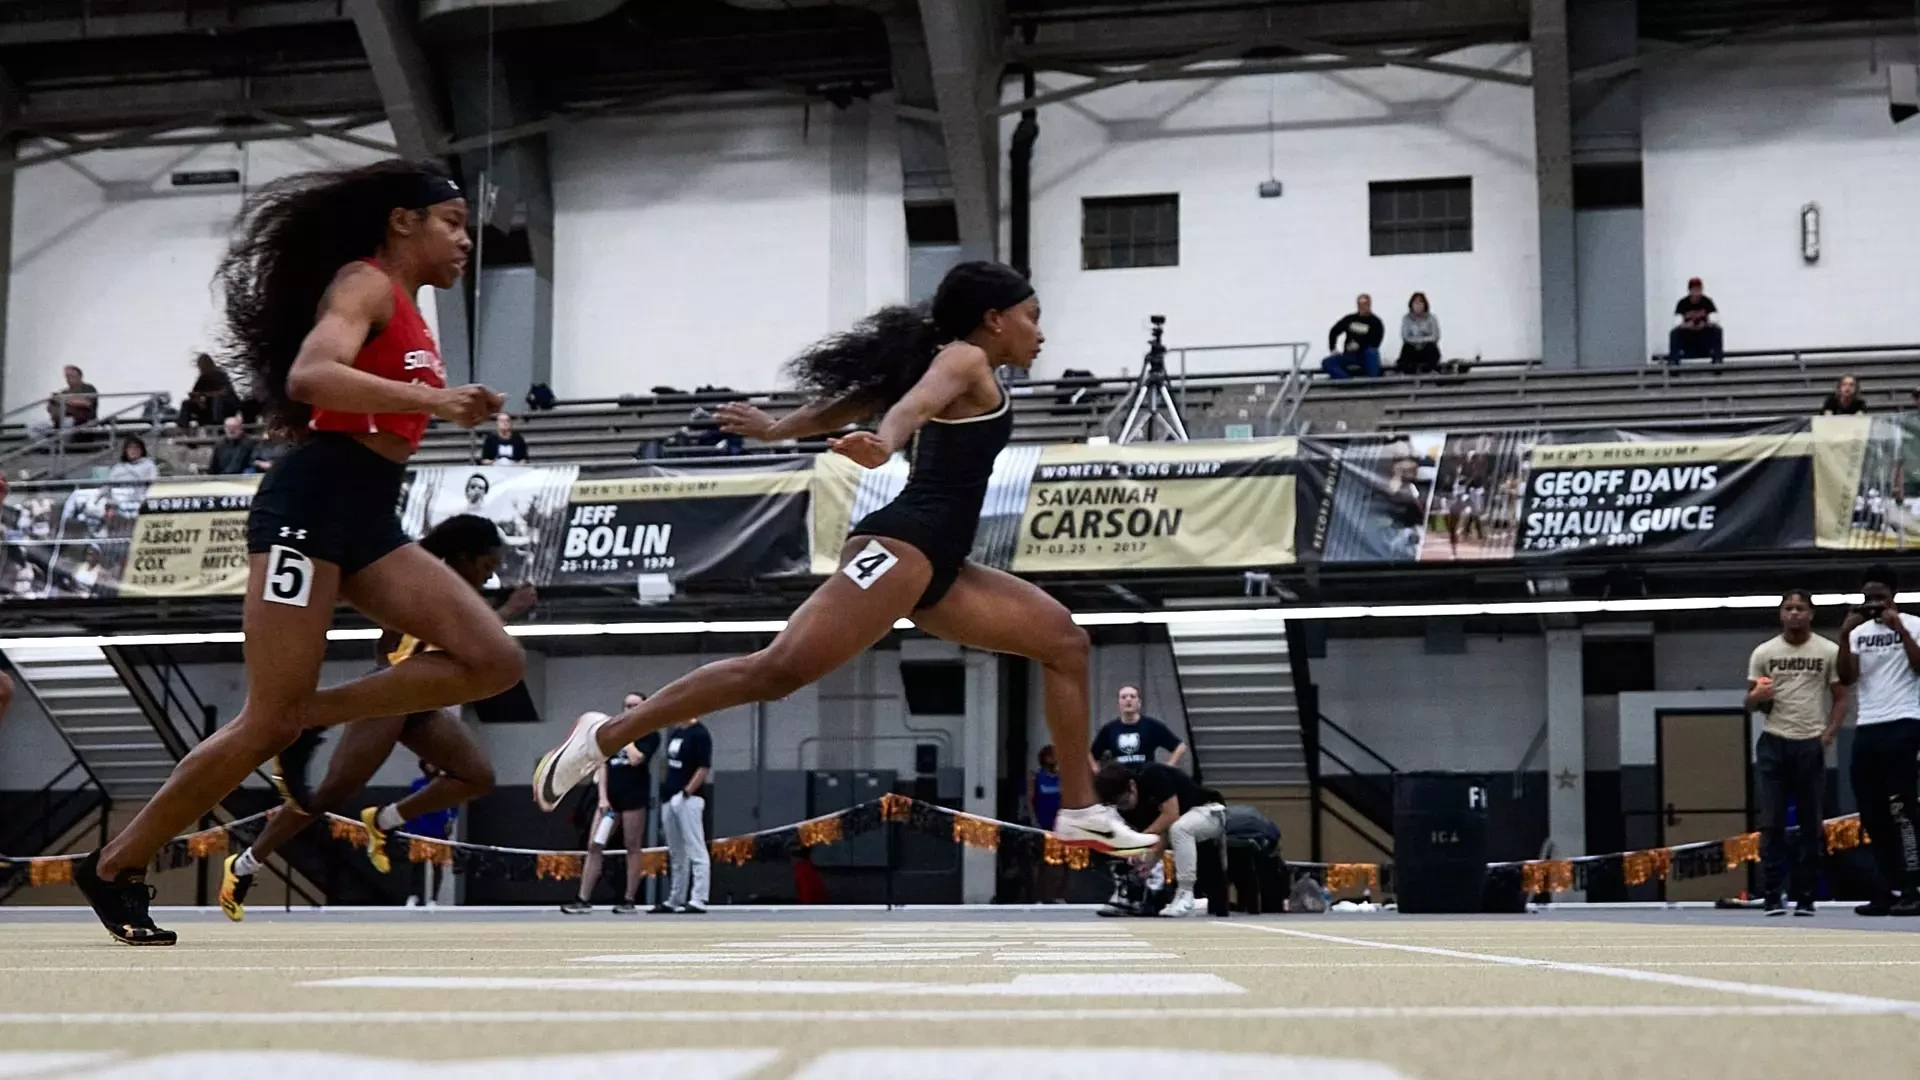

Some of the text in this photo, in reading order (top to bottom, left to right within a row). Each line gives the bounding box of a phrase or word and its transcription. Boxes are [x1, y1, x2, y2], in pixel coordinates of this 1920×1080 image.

[1542, 445, 1699, 461] MEN'S HIGH JUMP
[1041, 462, 1222, 479] WOMEN'S LONG JUMP
[579, 481, 718, 496] MEN'S LONG JUMP
[1534, 465, 1718, 497] GEOFF DAVIS
[1037, 487, 1158, 506] SAVANNAH
[1615, 493, 1653, 507] 2013
[570, 505, 618, 526] JEFF
[1030, 508, 1183, 540] CARSON
[1526, 505, 1716, 537] SHAUN GUICE
[563, 524, 672, 558] BOLIN
[1113, 542, 1147, 553] 2017
[1606, 533, 1644, 546] 2001
[134, 557, 167, 571] COX
[856, 552, 889, 580] 4
[272, 549, 304, 599] 5
[1857, 630, 1903, 648] PURDU
[1769, 657, 1824, 672] PURDUE
